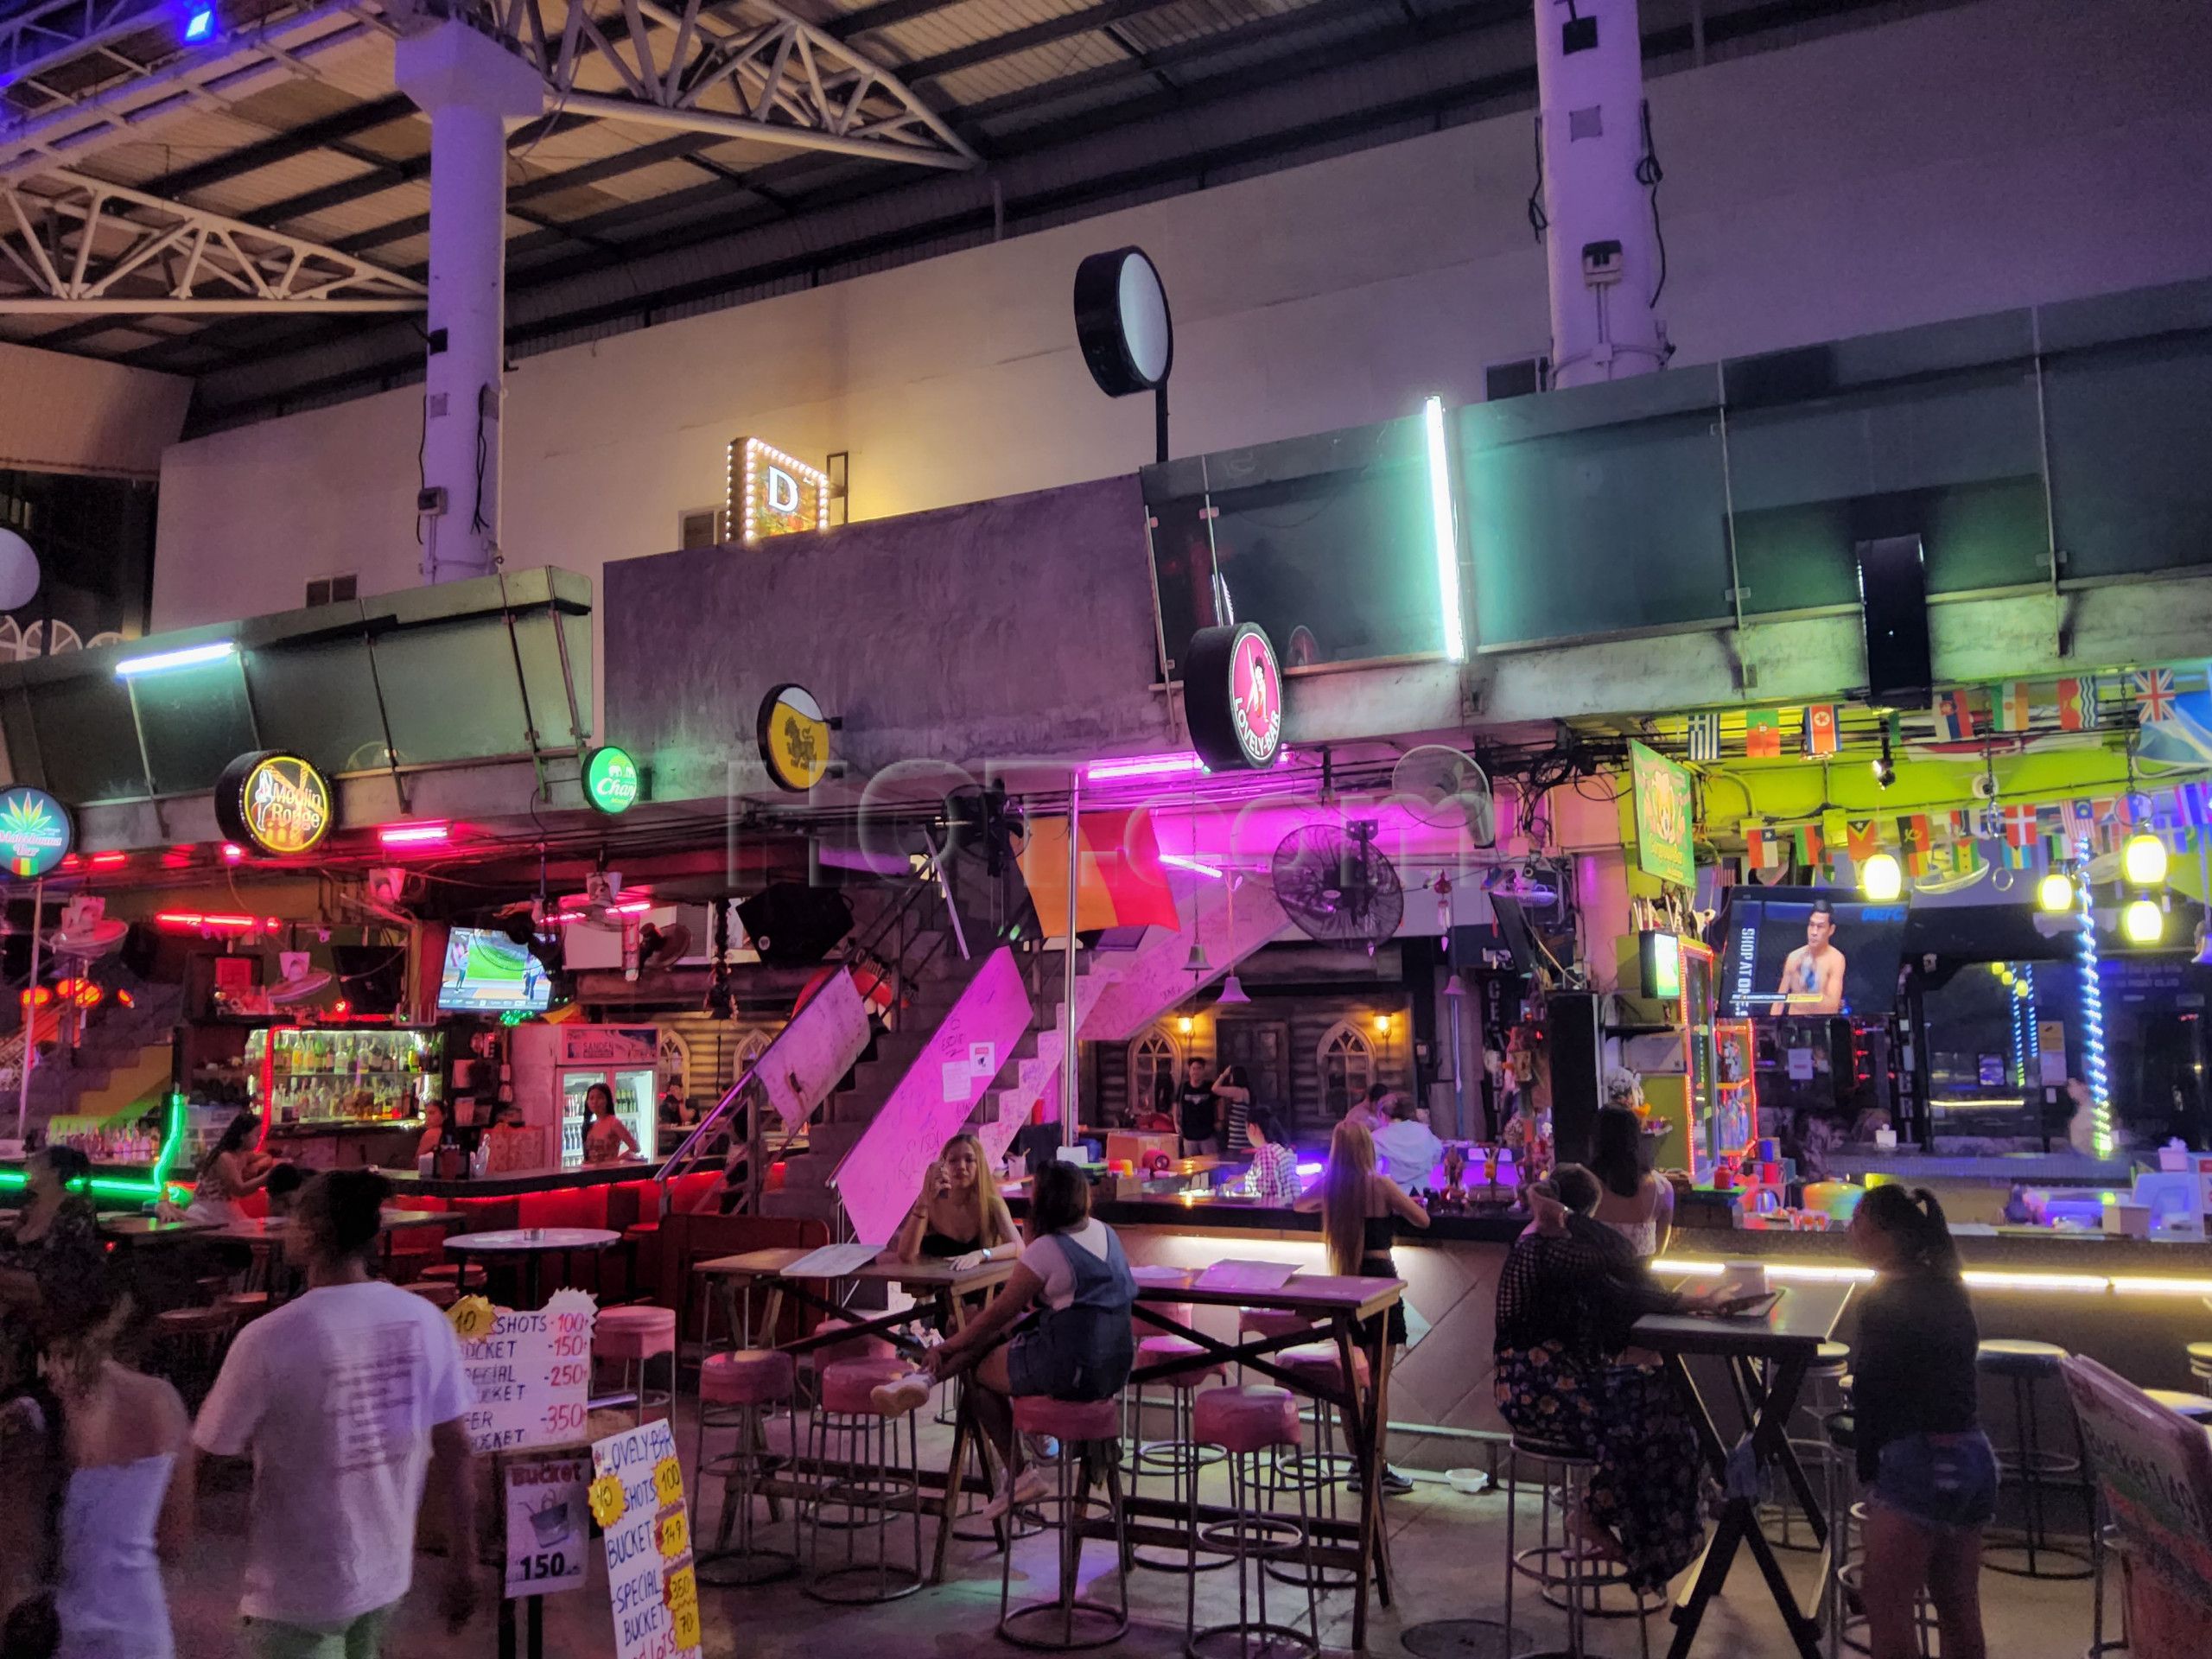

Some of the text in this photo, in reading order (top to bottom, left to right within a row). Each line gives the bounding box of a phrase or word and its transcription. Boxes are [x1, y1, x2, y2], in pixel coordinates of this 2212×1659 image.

[768, 466, 799, 512] D
[273, 782, 321, 809] Moulin
[596, 777, 637, 798] Chan
[271, 803, 321, 830] Rouge
[1740, 928, 1756, 960] SHOP
[1738, 962, 1753, 977] AT
[454, 1310, 476, 1333] 10
[495, 1315, 547, 1334] SHOTS
[464, 1341, 517, 1361] UCKET
[624, 1476, 657, 1513] SHOTS
[661, 1463, 681, 1492] 100
[607, 1520, 653, 1570] BUCKET
[519, 1552, 564, 1580] 150
[624, 1600, 665, 1648] BUCKET
